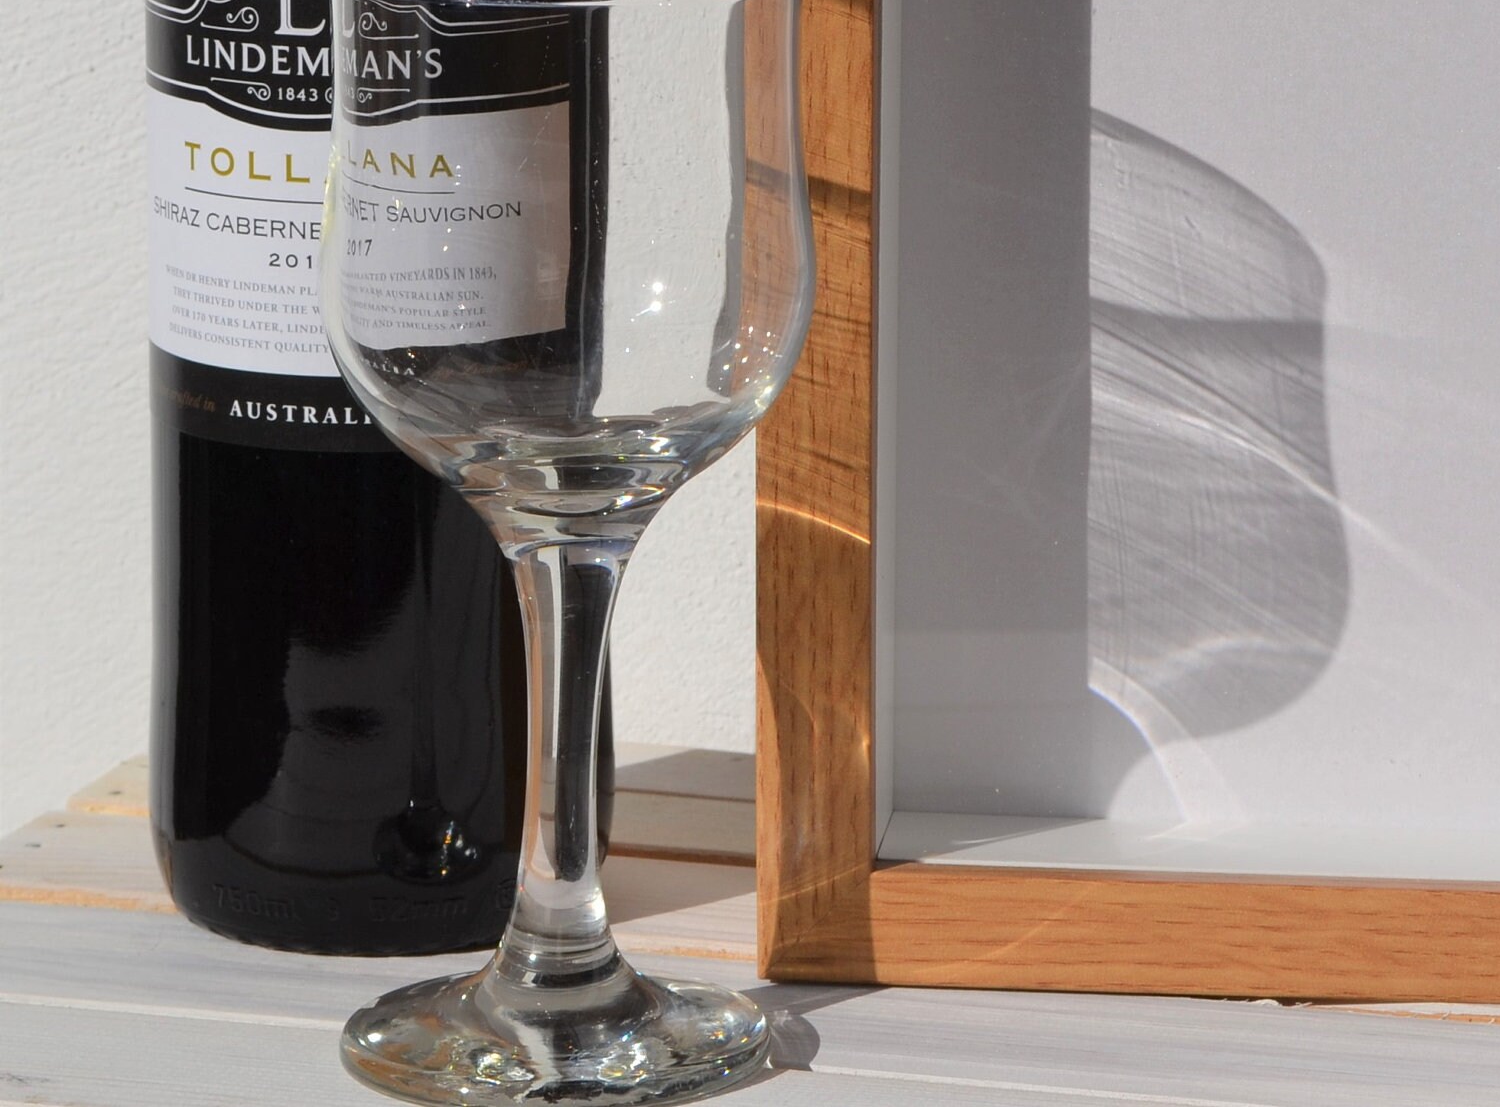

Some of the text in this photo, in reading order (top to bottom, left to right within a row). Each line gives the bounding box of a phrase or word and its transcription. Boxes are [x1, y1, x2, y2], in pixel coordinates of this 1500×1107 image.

[277, 87, 319, 102] 1843
[154, 196, 200, 228] SHIRAZ
[386, 201, 522, 224] SAUVIGNON
[199, 274, 230, 288] HENRY
[233, 280, 296, 295] LINDEMAN
[300, 286, 318, 297] PL
[390, 267, 450, 282] VINEYARDS
[454, 267, 466, 280] IN
[194, 292, 235, 308] THRIVED
[239, 301, 278, 313] UNDER
[283, 304, 308, 315] THE
[386, 289, 454, 302] AUSTRALIAN
[457, 291, 484, 301] SUN.
[208, 314, 240, 328] YEARS
[243, 322, 283, 334] LATER,
[400, 307, 448, 318] POPULAR
[453, 307, 486, 317] STYLE
[169, 322, 202, 340] DELIVERS
[204, 333, 270, 350] CONSISTENT
[274, 343, 329, 354] QUALITY
[372, 319, 393, 329] AND
[396, 321, 446, 331] TIMELESS
